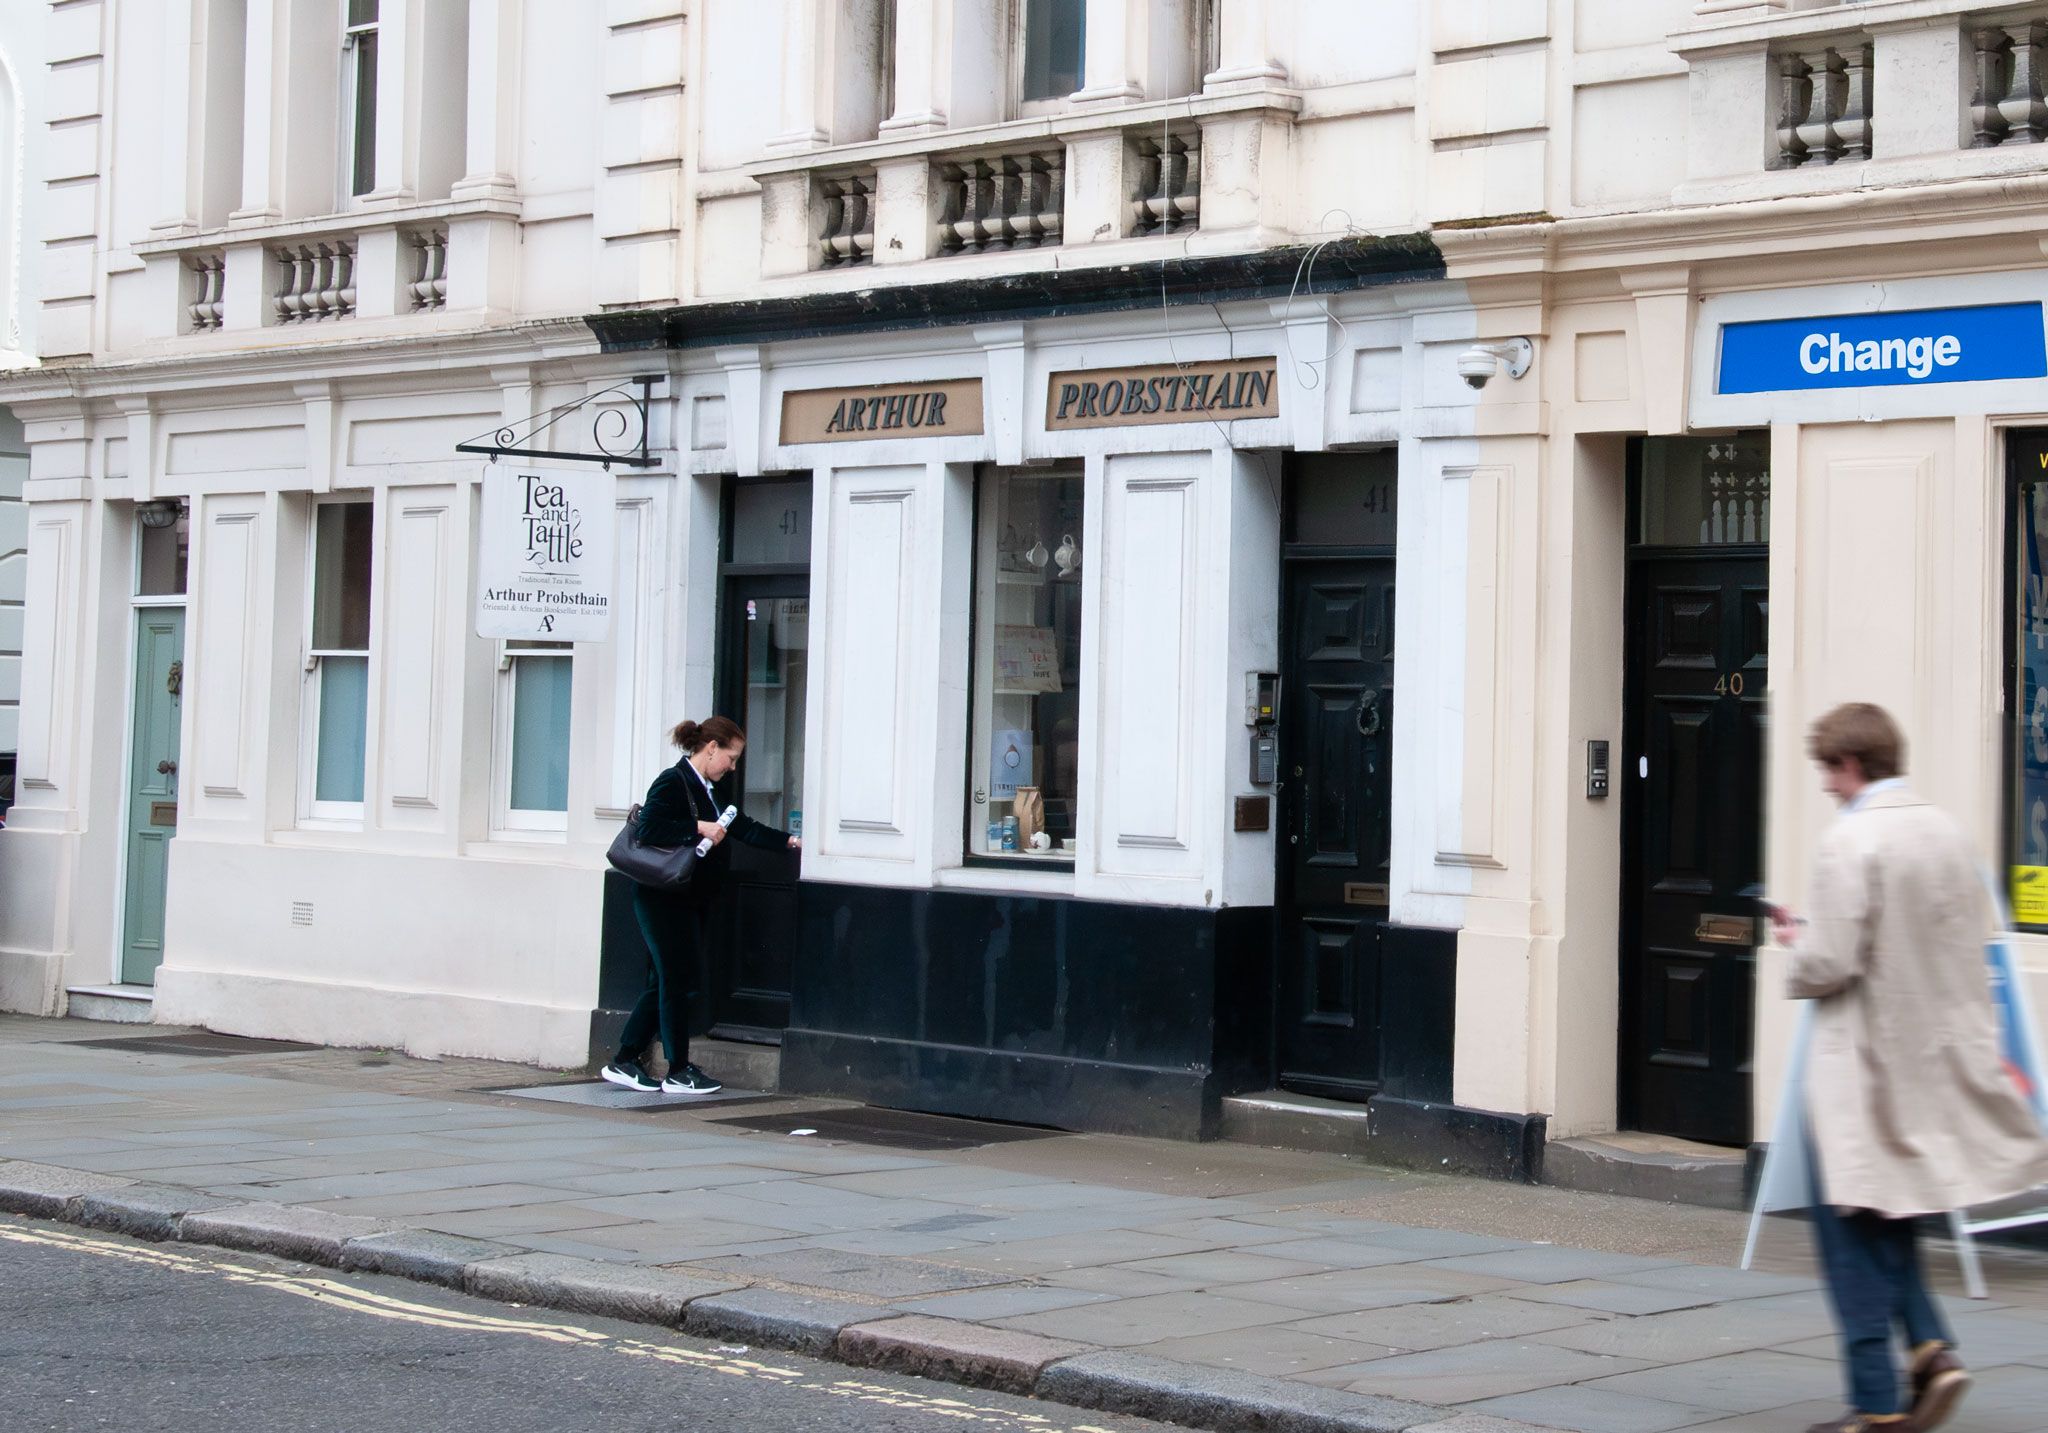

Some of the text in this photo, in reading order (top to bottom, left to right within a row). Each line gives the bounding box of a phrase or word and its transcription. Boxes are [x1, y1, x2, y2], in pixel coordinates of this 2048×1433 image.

[1799, 332, 1962, 379] Change
[825, 369, 1277, 433] ARTHUR PROBSTHAIN
[518, 475, 565, 515] Tea
[1362, 484, 1389, 513] 41
[541, 501, 569, 525] and
[779, 509, 799, 535] 41
[523, 517, 583, 563] Tattle
[518, 576, 550, 584] Traditional
[552, 577, 563, 585] Tea
[482, 603, 509, 611] Oriental
[519, 605, 543, 613] African
[544, 607, 577, 615] Bookseller
[484, 588, 608, 606] Arthur Probsthain
[1713, 672, 1744, 696] 40
